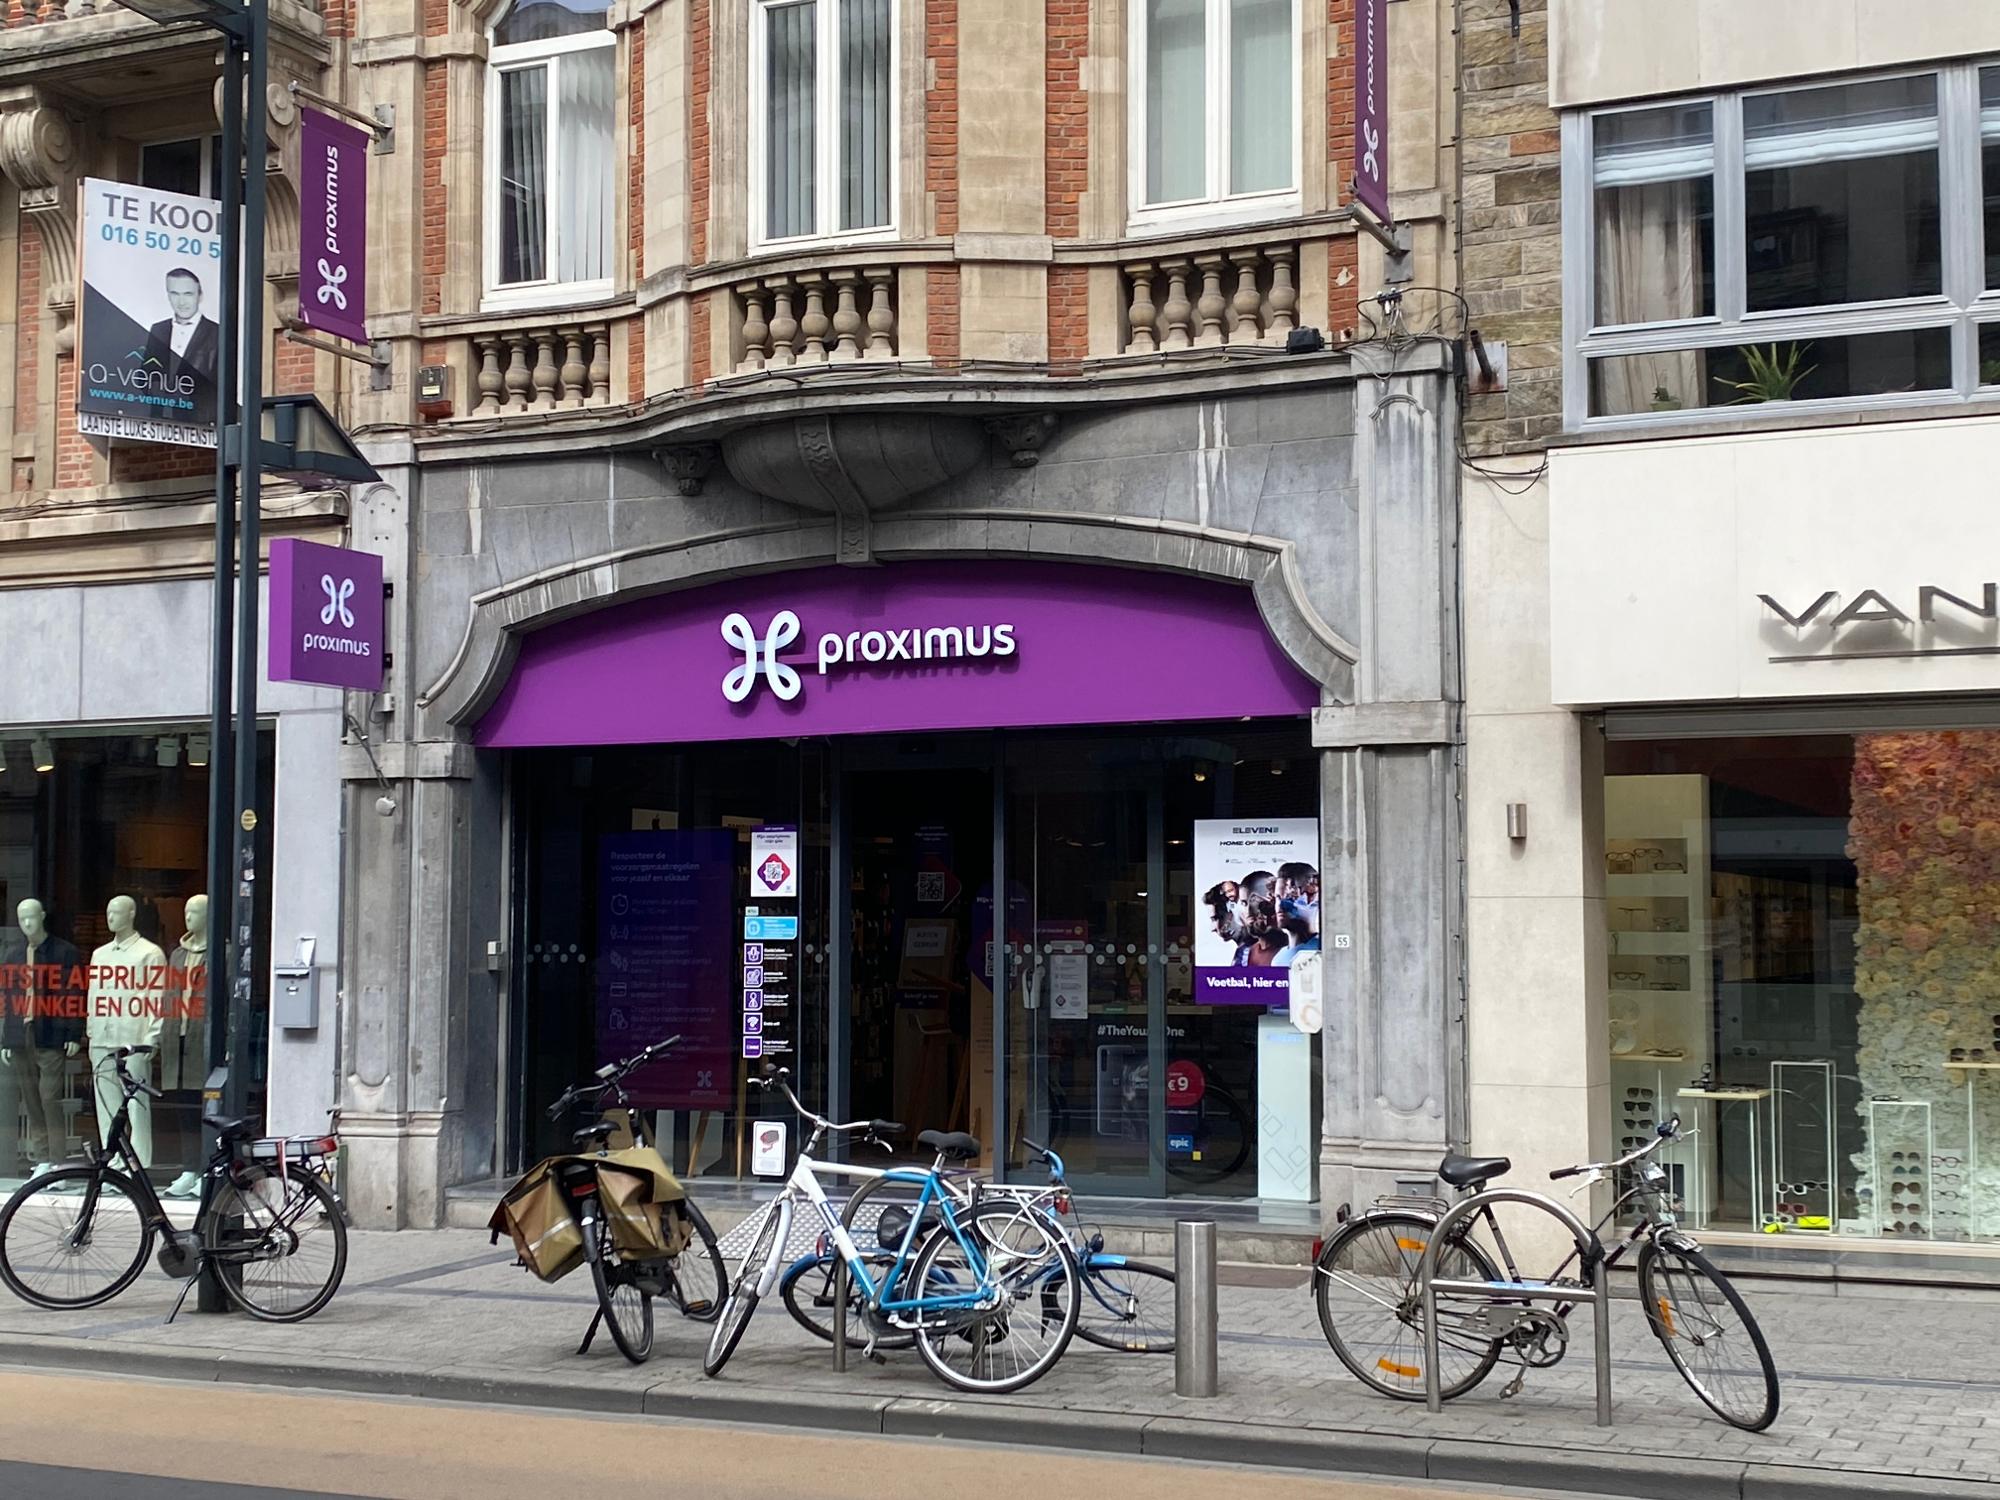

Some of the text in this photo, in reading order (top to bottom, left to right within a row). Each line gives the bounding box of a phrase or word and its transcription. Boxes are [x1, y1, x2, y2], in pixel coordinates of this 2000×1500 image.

[1366, 0, 1376, 115] proximu
[102, 193, 139, 221] TE
[326, 145, 340, 254] proximus
[102, 224, 221, 259] 016 50 20 5
[89, 363, 195, 395] a-venue
[89, 388, 194, 410] www.a-venue.be
[82, 413, 218, 446] LAATSTE LUXE-STUDENTENSTU
[1756, 583, 1996, 627] VAN
[303, 633, 370, 656] proximus
[818, 623, 1016, 674] proximus
[1337, 937, 1348, 946] 55
[66, 963, 208, 991] AFPRIJZING
[1206, 976, 1289, 989] Voetbal, hier en
[12, 995, 89, 1018] WINKEL
[95, 996, 122, 1018] EN
[128, 995, 206, 1018] ONLINE
[1169, 1138, 1190, 1149] epic
